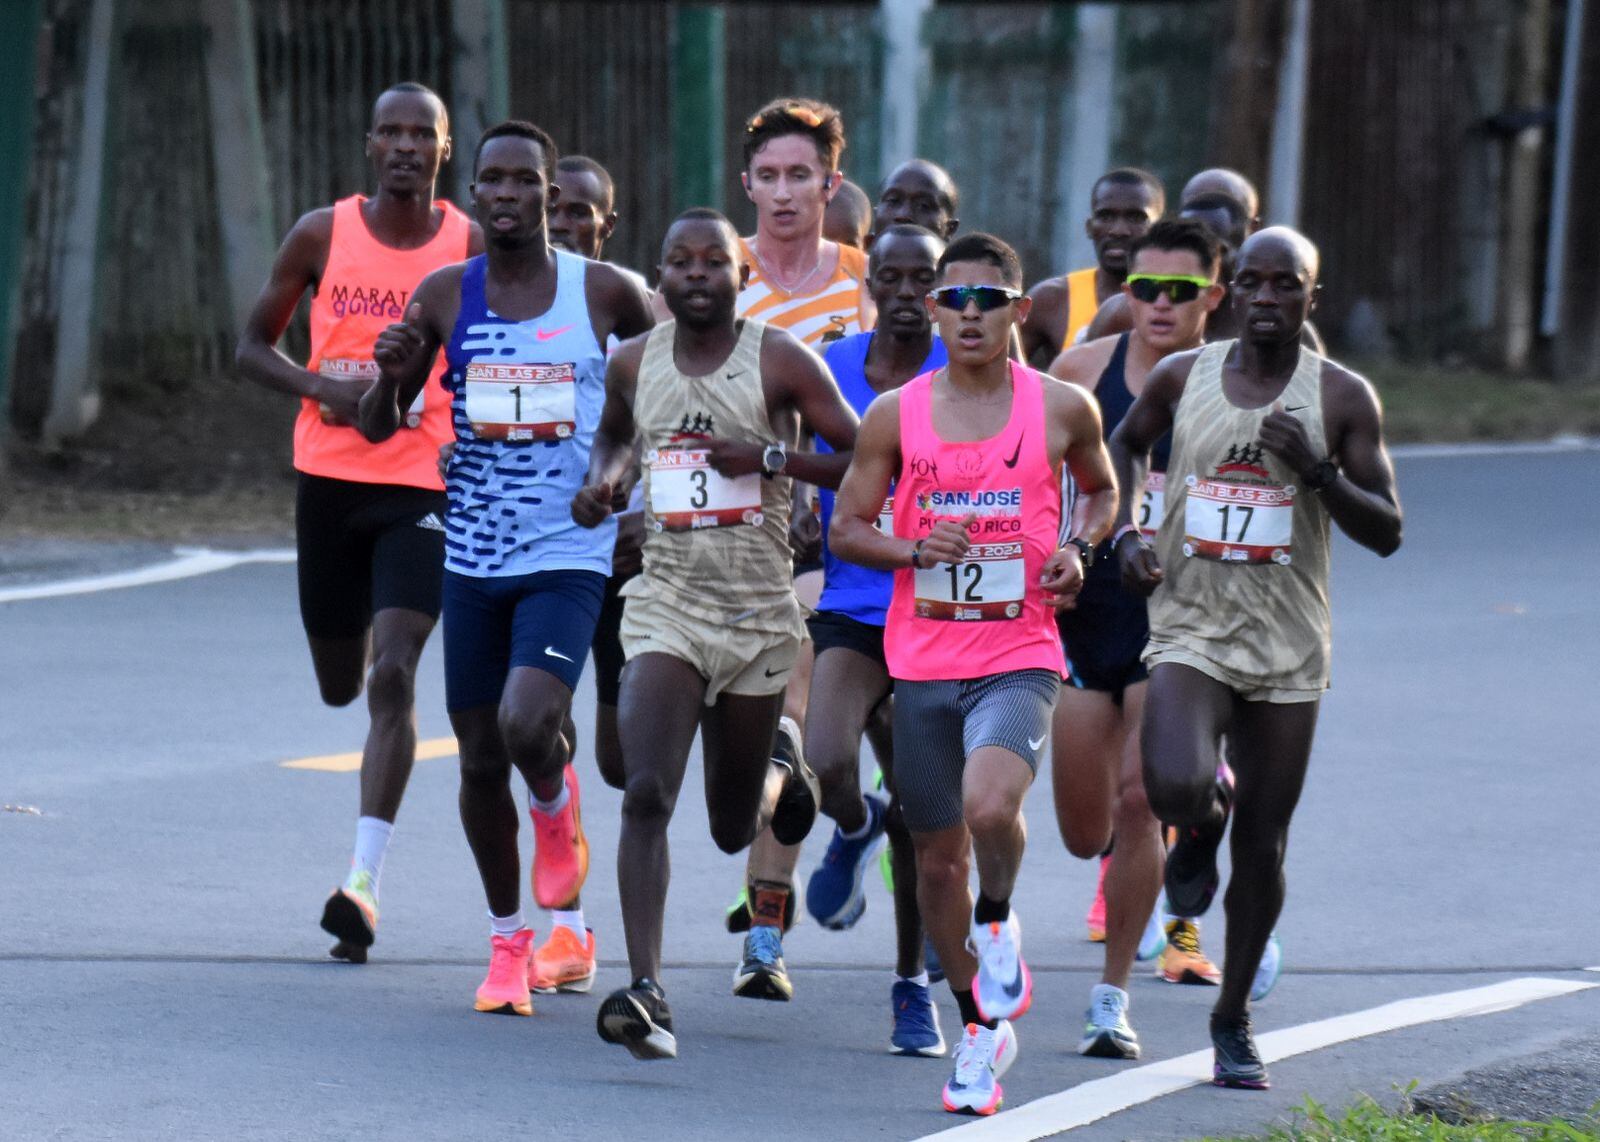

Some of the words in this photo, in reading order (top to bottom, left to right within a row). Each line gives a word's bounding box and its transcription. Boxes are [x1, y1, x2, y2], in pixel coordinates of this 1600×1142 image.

[331, 285, 409, 307] MARAT
[466, 367, 494, 378] SAN
[497, 368, 533, 380] BLAS
[535, 368, 573, 379] 2024
[509, 385, 521, 422] 1
[690, 470, 708, 509] 3
[931, 490, 970, 506] SAN
[972, 488, 1021, 507] JOSÉ
[1217, 487, 1254, 500] BLAS
[919, 517, 981, 534] PUO
[1217, 504, 1254, 543] 17
[983, 544, 1023, 557] 2024
[944, 562, 984, 602] 12
